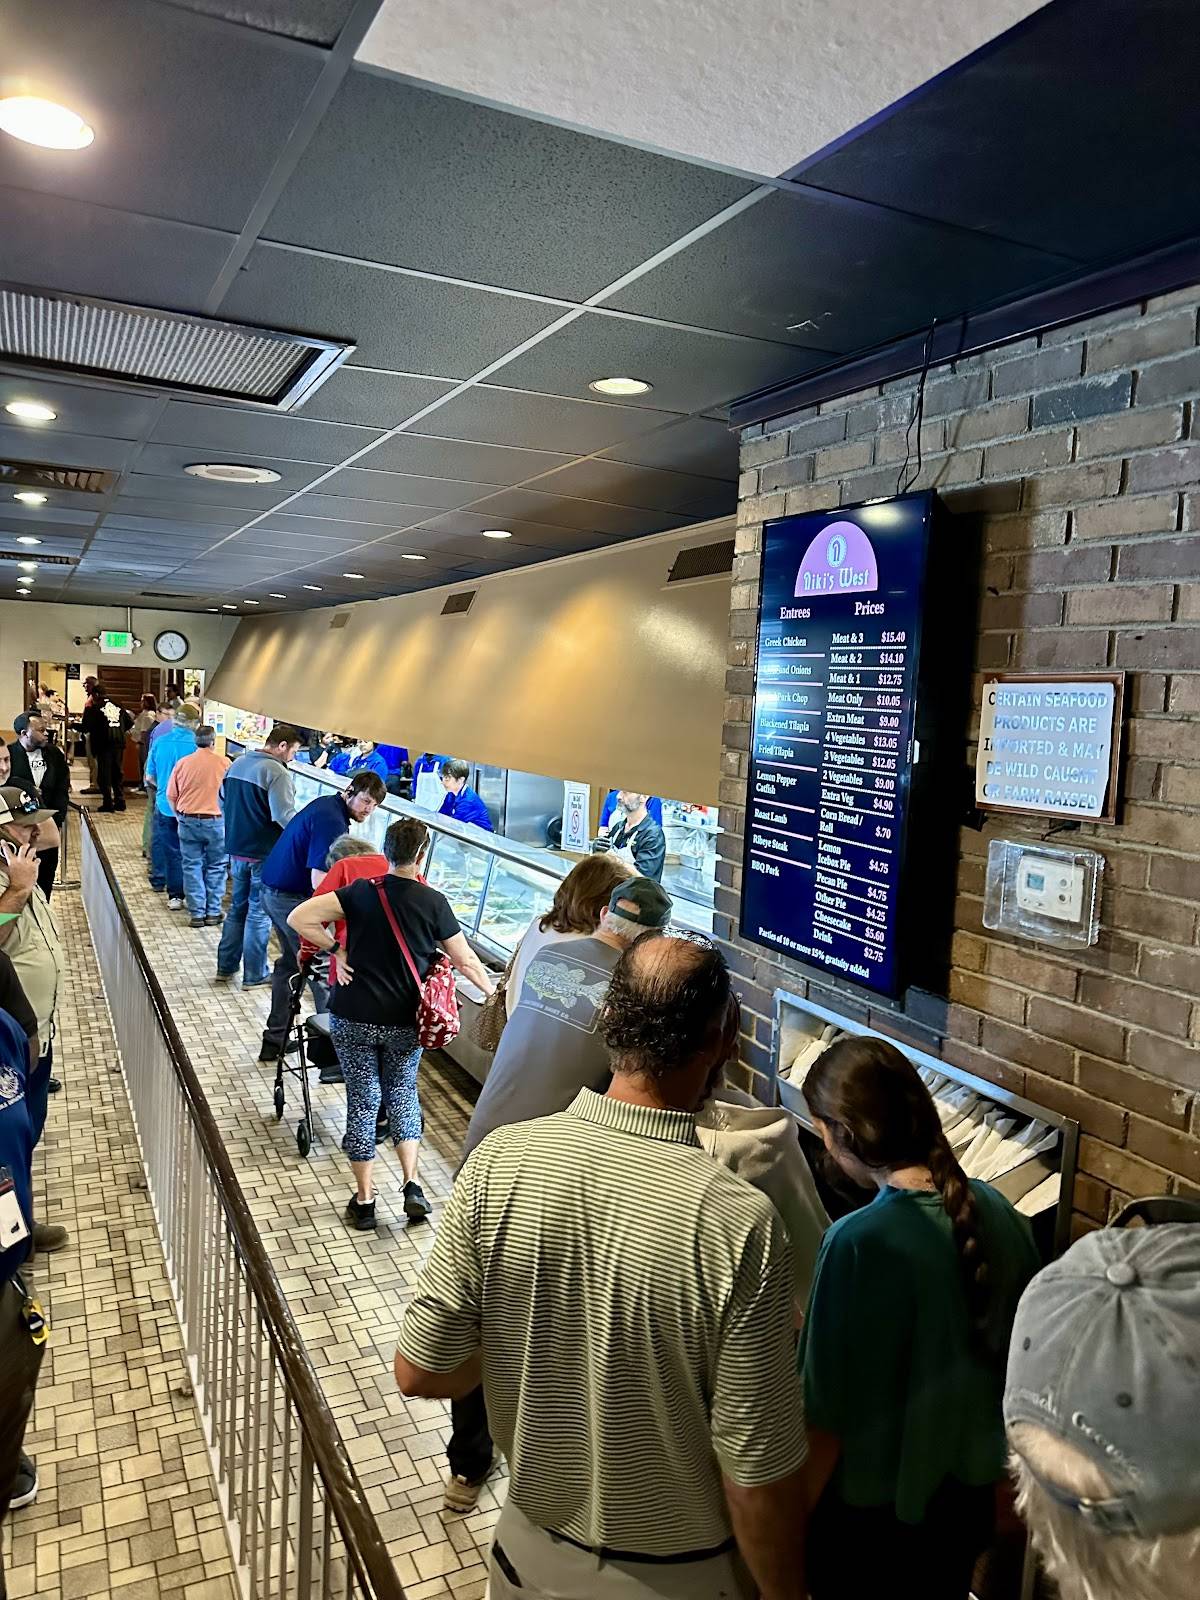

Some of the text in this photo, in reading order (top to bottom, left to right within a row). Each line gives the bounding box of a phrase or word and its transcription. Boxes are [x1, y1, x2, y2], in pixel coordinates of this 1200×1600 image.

[839, 567, 869, 588] West
[780, 606, 811, 619] Entrees
[854, 600, 885, 616] Prices
[764, 636, 807, 647] Greek Chicken
[832, 631, 906, 644] Meat & 3 $15.40
[830, 652, 904, 664] Meat & 2 $14.10
[790, 665, 812, 675] Onions
[829, 673, 903, 685] Meat & 1 $12.75
[792, 692, 809, 706] Chop
[827, 692, 901, 707] Meat Only $10.05
[988, 691, 1108, 709] CERTAIN SEAFOOD
[760, 718, 810, 733] Blackened Tilapia
[826, 711, 899, 727] Extra Meat $9.00
[994, 715, 1097, 734] PRODUCTS ARE
[825, 731, 898, 749] 4 Vegetables $13.05
[758, 744, 794, 759] Fried Tilapia
[823, 750, 896, 769] 3 Vegetables $12.05
[1058, 741, 1069, 757] &
[1072, 742, 1104, 760] MAY
[756, 770, 798, 787] Lemon Pepper
[822, 770, 895, 791] 2 Vegetables $9.00
[986, 760, 1099, 785] BE WILD CAUGHT
[755, 783, 776, 795] Catfish
[982, 783, 1098, 810] OR FARM RAISED
[821, 788, 894, 811] Extra Veg $4.90
[754, 808, 788, 825] Roast Lamb
[820, 808, 864, 826] Corn Bread /
[819, 821, 834, 834] Roll
[875, 825, 892, 840] $.70
[752, 834, 789, 852] Ribeye Steak
[818, 840, 842, 855] Lemon
[751, 859, 780, 877] BBQ Pork
[817, 853, 889, 874] Icebox Pie $4.75
[816, 871, 887, 902] Pecan Pie $4.75
[815, 890, 886, 922] Other Pie $4.25
[814, 910, 885, 942] Cheesecake $5.60
[758, 926, 870, 979] Parties of 10 or more 15% gratuity added
[812, 927, 884, 963] Drink $2.75
